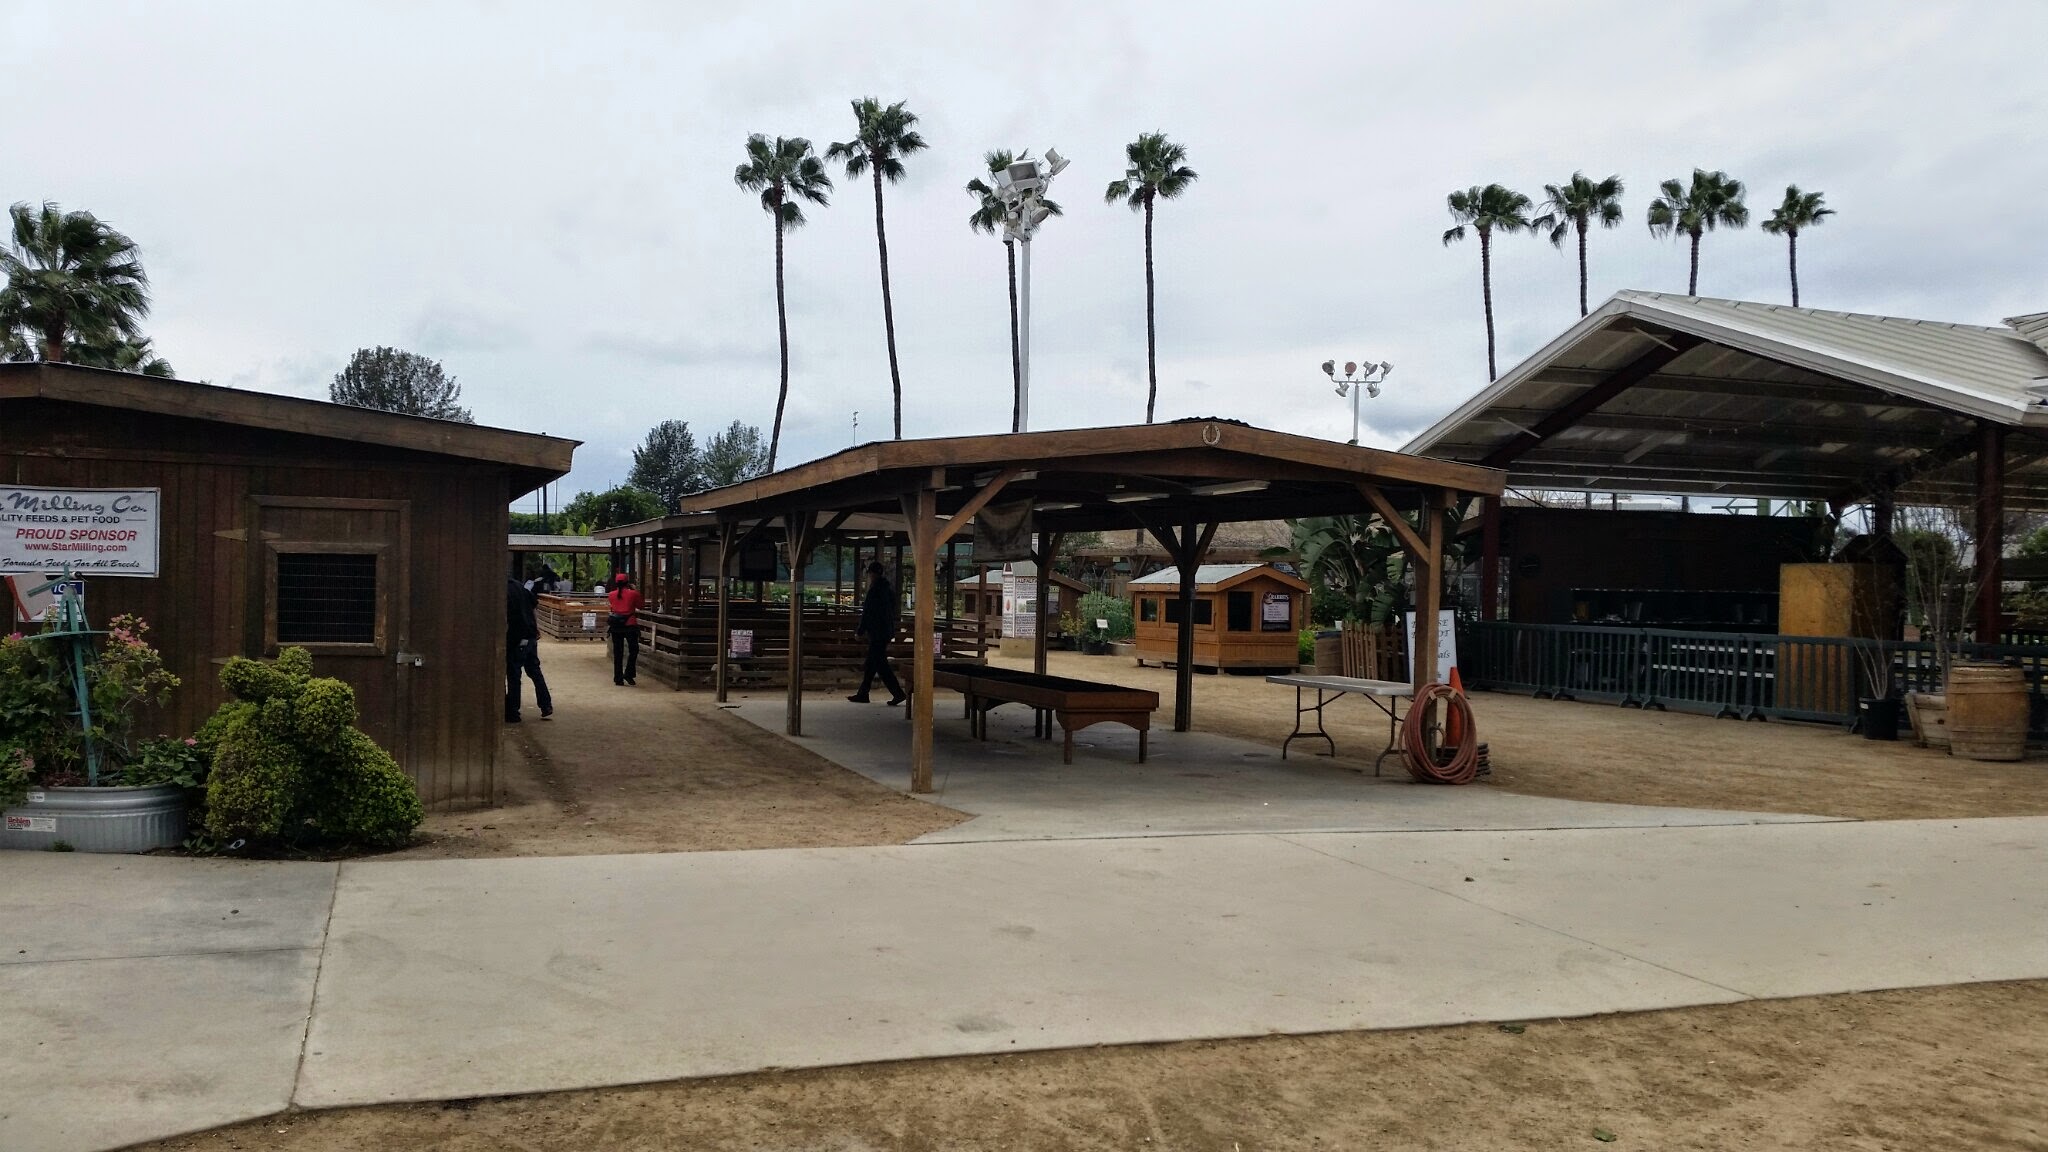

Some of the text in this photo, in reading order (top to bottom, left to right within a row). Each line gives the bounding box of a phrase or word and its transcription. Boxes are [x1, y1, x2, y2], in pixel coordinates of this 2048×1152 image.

[7, 492, 147, 515] Milling Co.
[25, 515, 59, 523] FEEDS
[92, 516, 120, 524] FOOD
[16, 528, 137, 541] PROUD SPONSOR
[24, 542, 128, 553] www.StarMilling.com
[2, 558, 140, 568] Formula Feeds For All Breeds
